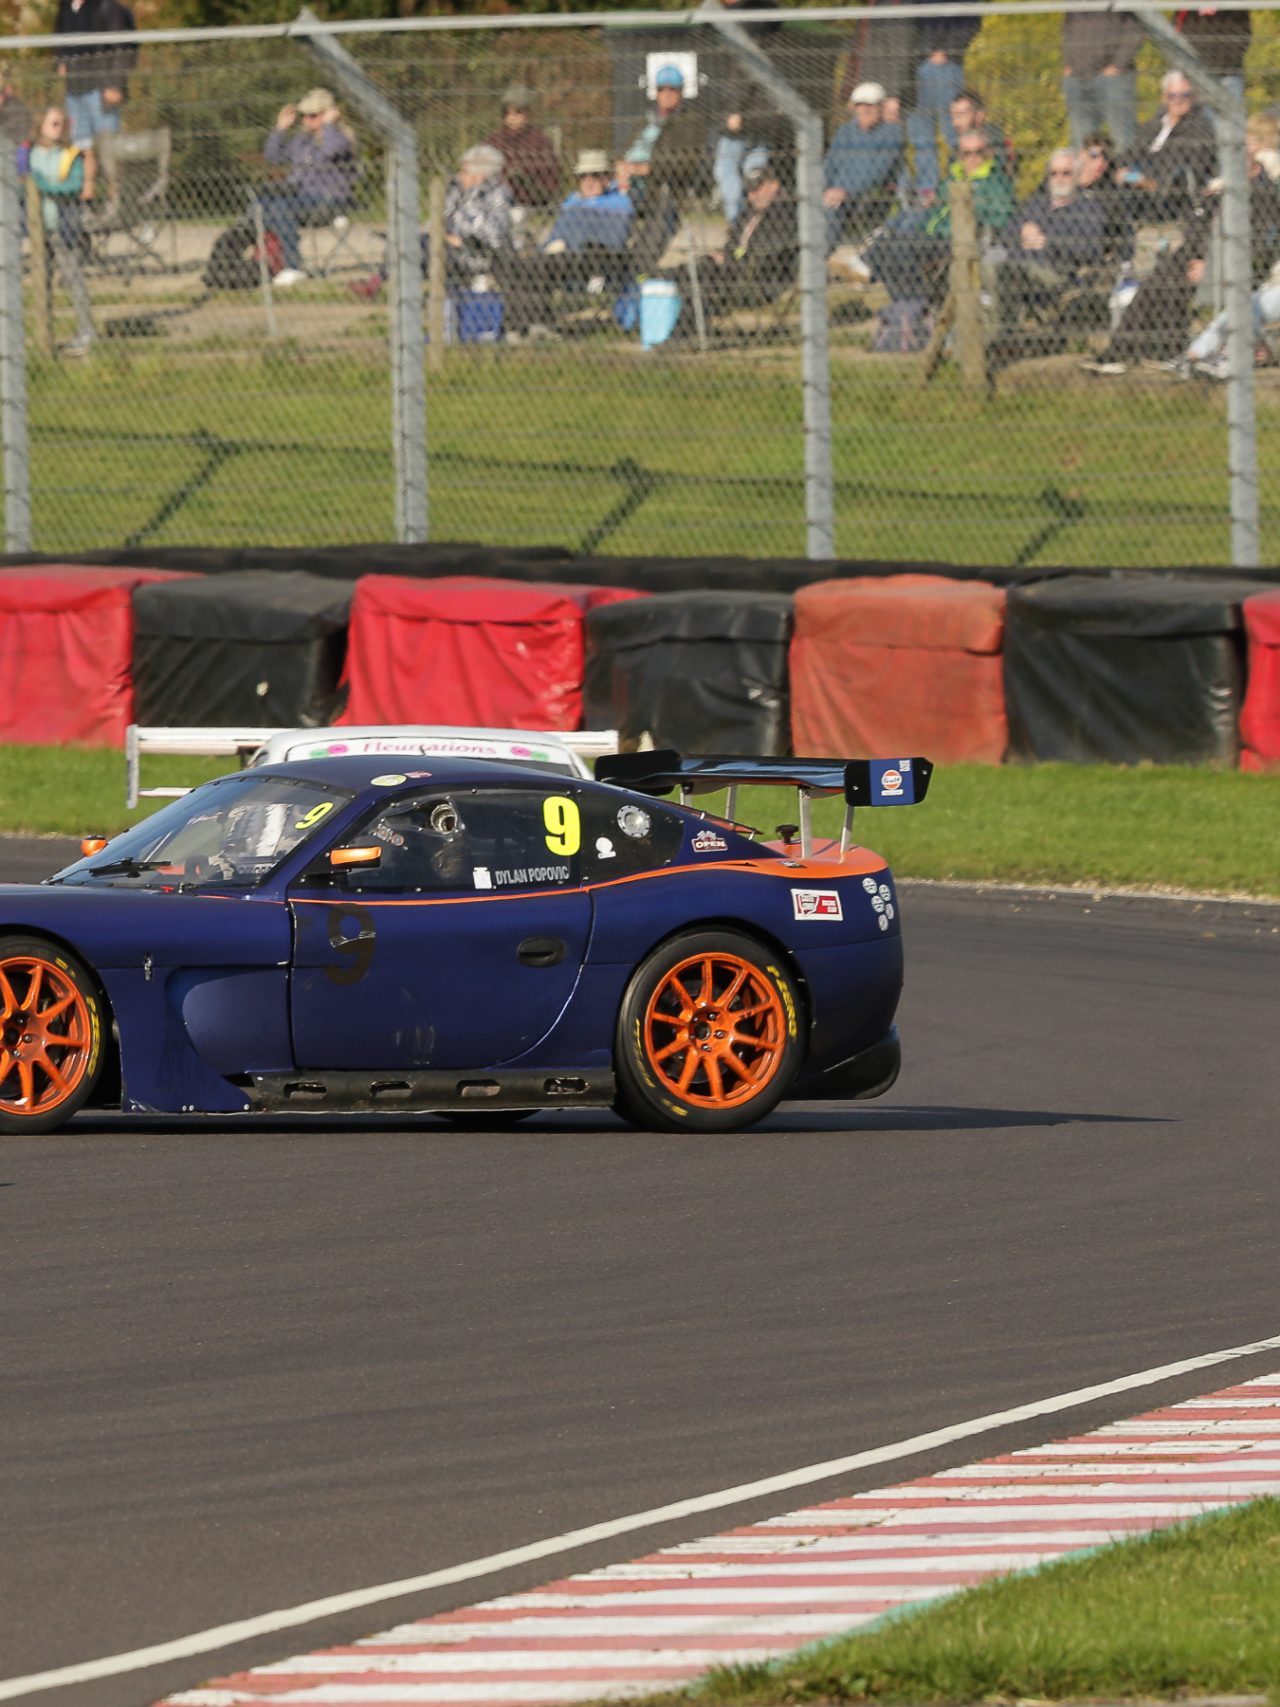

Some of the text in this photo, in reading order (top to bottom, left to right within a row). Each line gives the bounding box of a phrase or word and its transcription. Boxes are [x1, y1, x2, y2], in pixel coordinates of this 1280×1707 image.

[295, 802, 334, 830] 9
[543, 796, 581, 856] 9
[495, 866, 570, 886] DYLAN POPOVIC
[326, 903, 376, 986] 9
